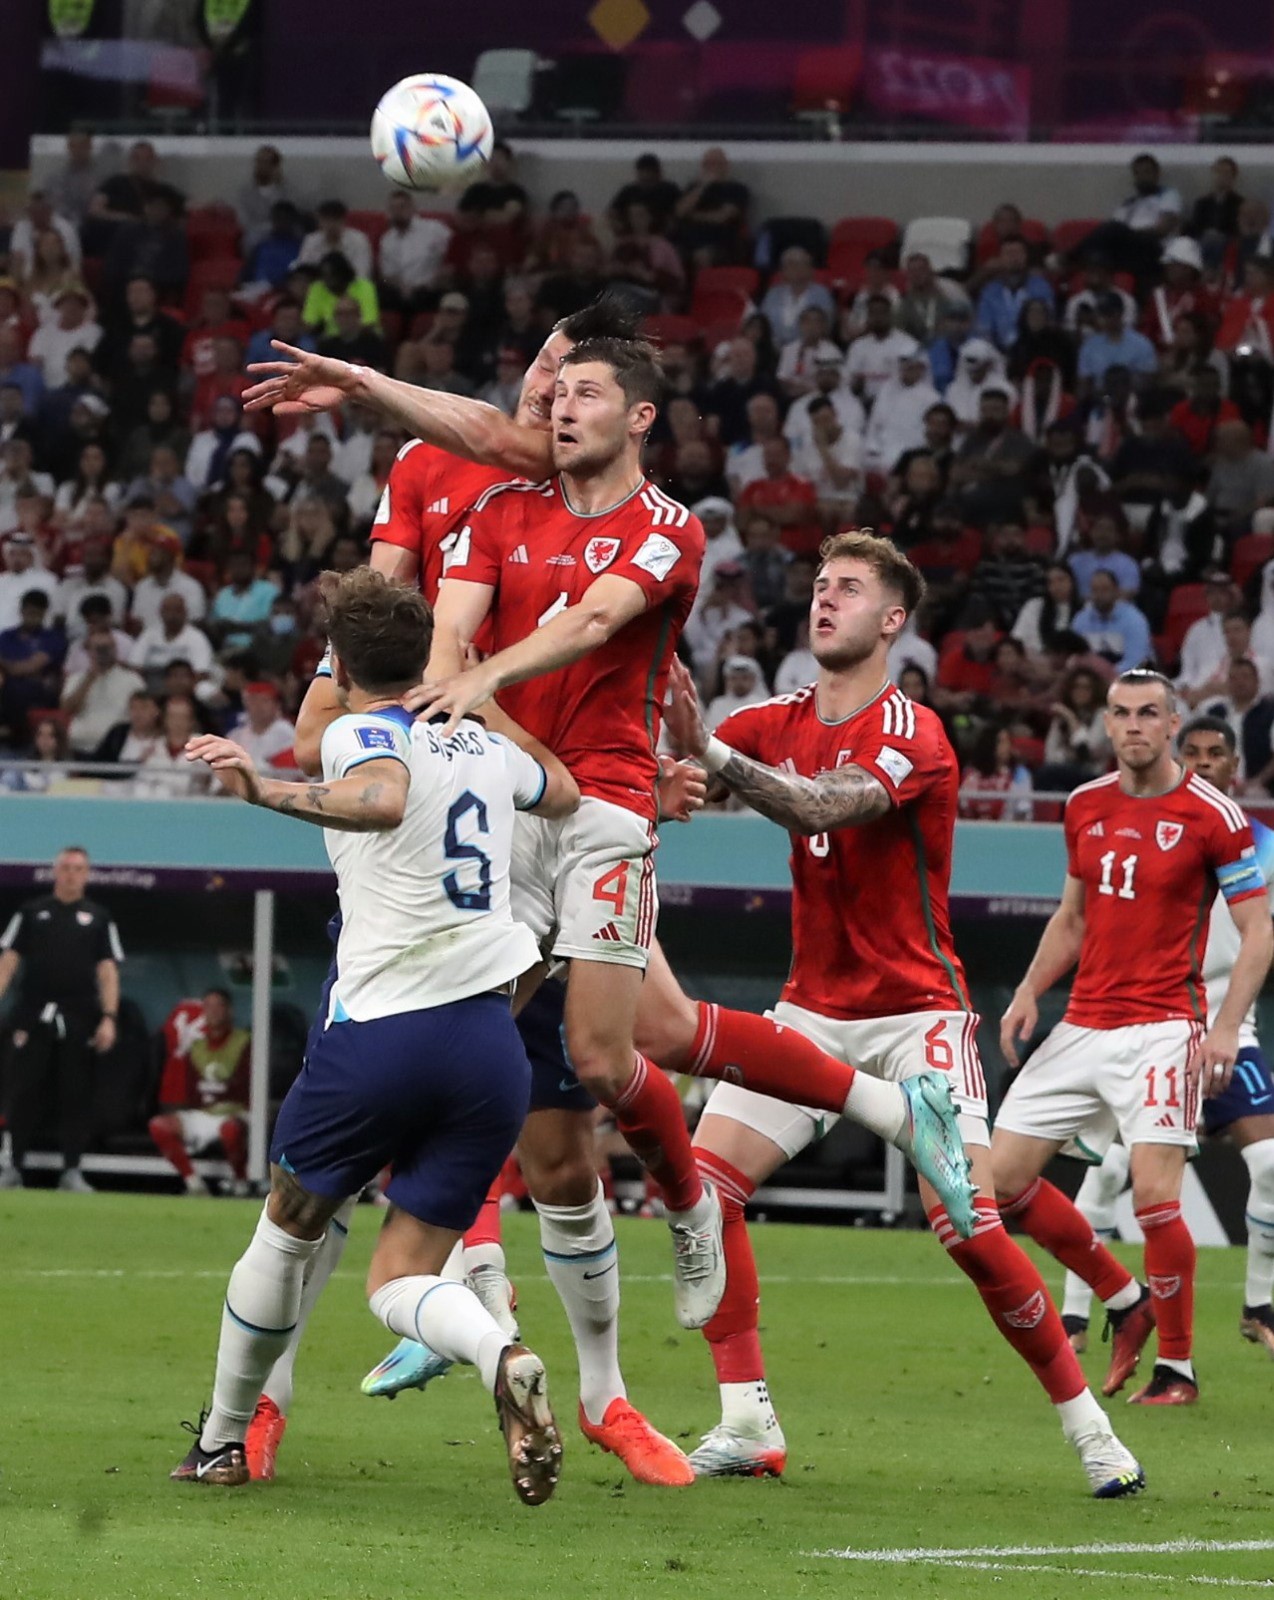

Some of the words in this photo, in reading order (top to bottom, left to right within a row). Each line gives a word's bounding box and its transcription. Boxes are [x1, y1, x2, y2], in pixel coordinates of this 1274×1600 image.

[443, 789, 492, 911] 5
[1098, 850, 1138, 900] 11
[592, 859, 630, 916] 4
[925, 1018, 953, 1071] 6
[1143, 1065, 1180, 1107] 11
[1234, 1060, 1266, 1094] 11
